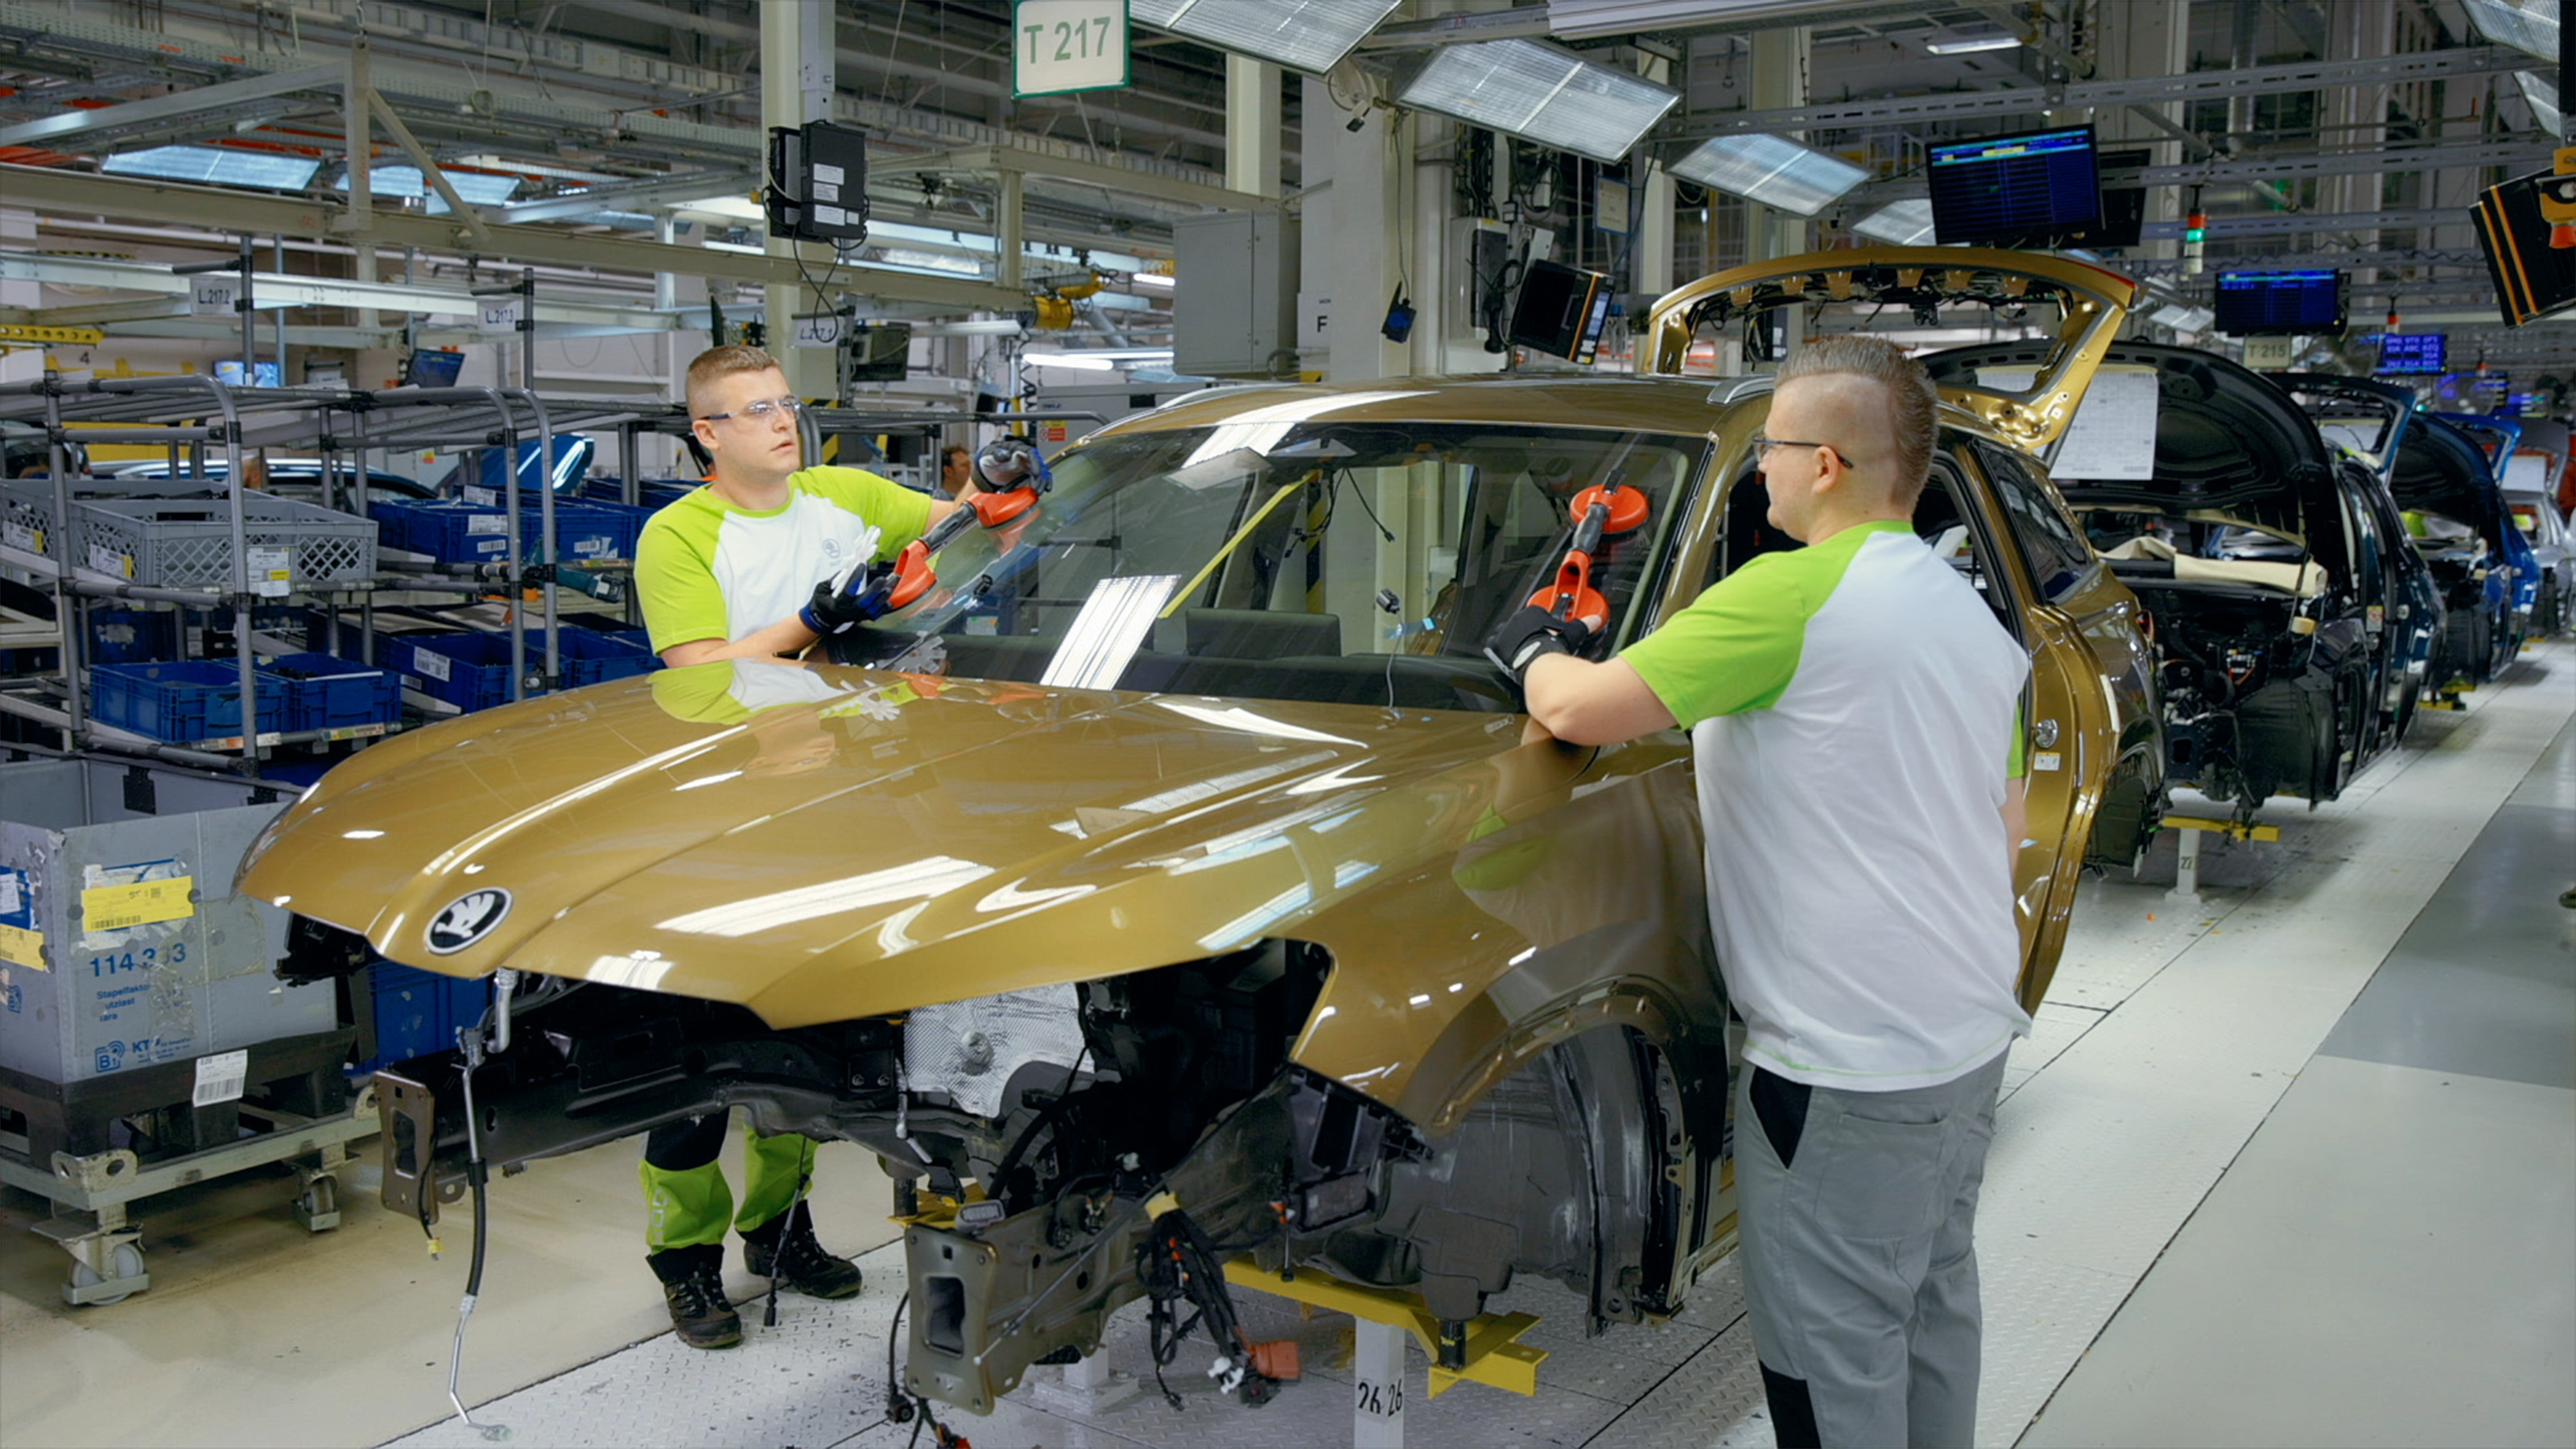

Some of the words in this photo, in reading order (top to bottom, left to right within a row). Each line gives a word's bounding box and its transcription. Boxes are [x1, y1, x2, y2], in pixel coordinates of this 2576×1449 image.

[1023, 23, 1043, 64] T
[1054, 16, 1111, 62] 217
[2248, 344, 2256, 358] T
[2260, 344, 2286, 357] 215
[89, 952, 135, 977] 114
[105, 997, 135, 1009] utzlast
[1358, 1381, 1381, 1414] 26
[1388, 1378, 1402, 1417] 26
